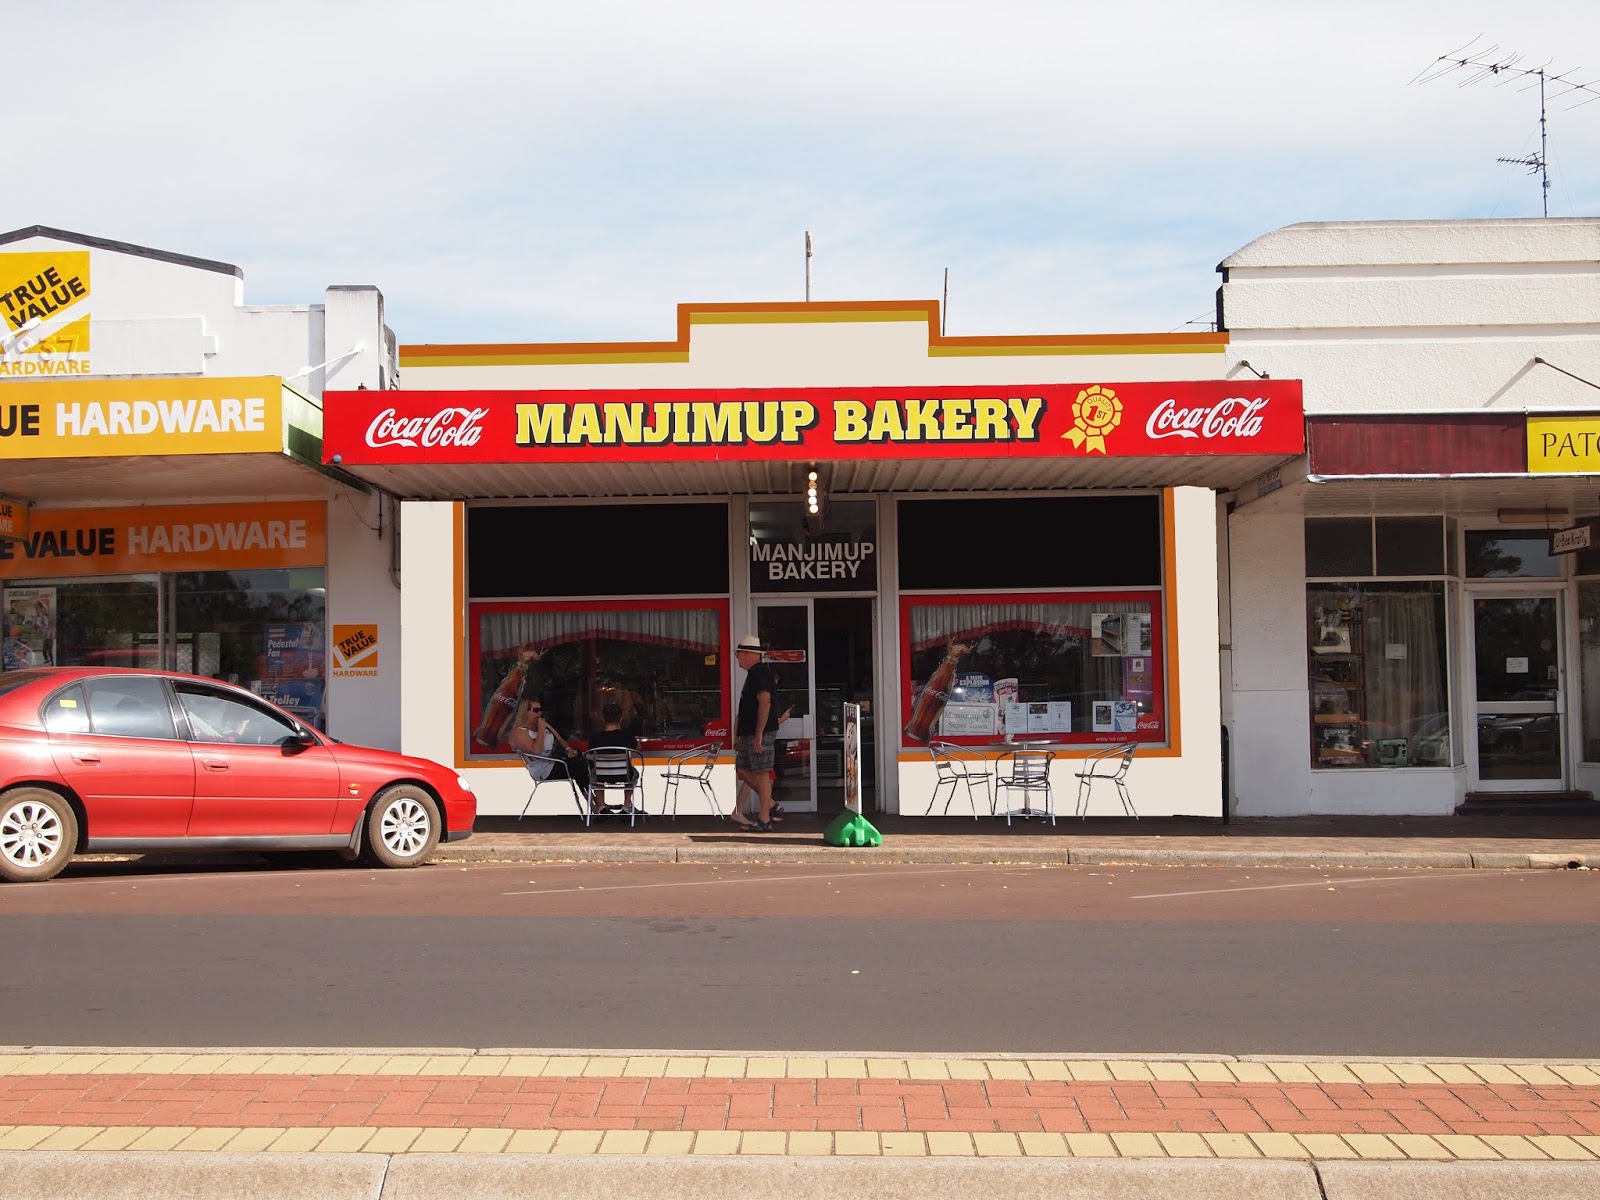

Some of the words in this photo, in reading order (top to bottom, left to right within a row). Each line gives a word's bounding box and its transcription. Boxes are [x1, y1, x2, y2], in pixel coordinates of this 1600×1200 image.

[0, 266, 62, 312] TRUE
[9, 276, 86, 328] VALUE
[1086, 396, 1112, 412] QUALITY
[1086, 405, 1107, 422] 1ST
[56, 398, 265, 437] HARDWARE
[365, 406, 490, 448] Coca-Cola
[515, 400, 819, 447] MANJIMUP
[832, 397, 1046, 444] BAKERY
[1145, 396, 1270, 439] Coca-Cola
[1540, 432, 1600, 458] PAT
[0, 504, 13, 518] UE
[23, 527, 115, 558] VALUE
[127, 519, 307, 555] HARDWARE
[752, 542, 874, 562] MANJIMUP
[768, 560, 861, 580] BAKERY
[267, 638, 299, 648] Pedestal
[339, 630, 366, 650] TRUE
[343, 635, 376, 658] VALUE
[267, 648, 281, 658] Fan
[270, 694, 300, 707] Trolley
[944, 711, 982, 721] Manjimup
[948, 722, 967, 730] Super
